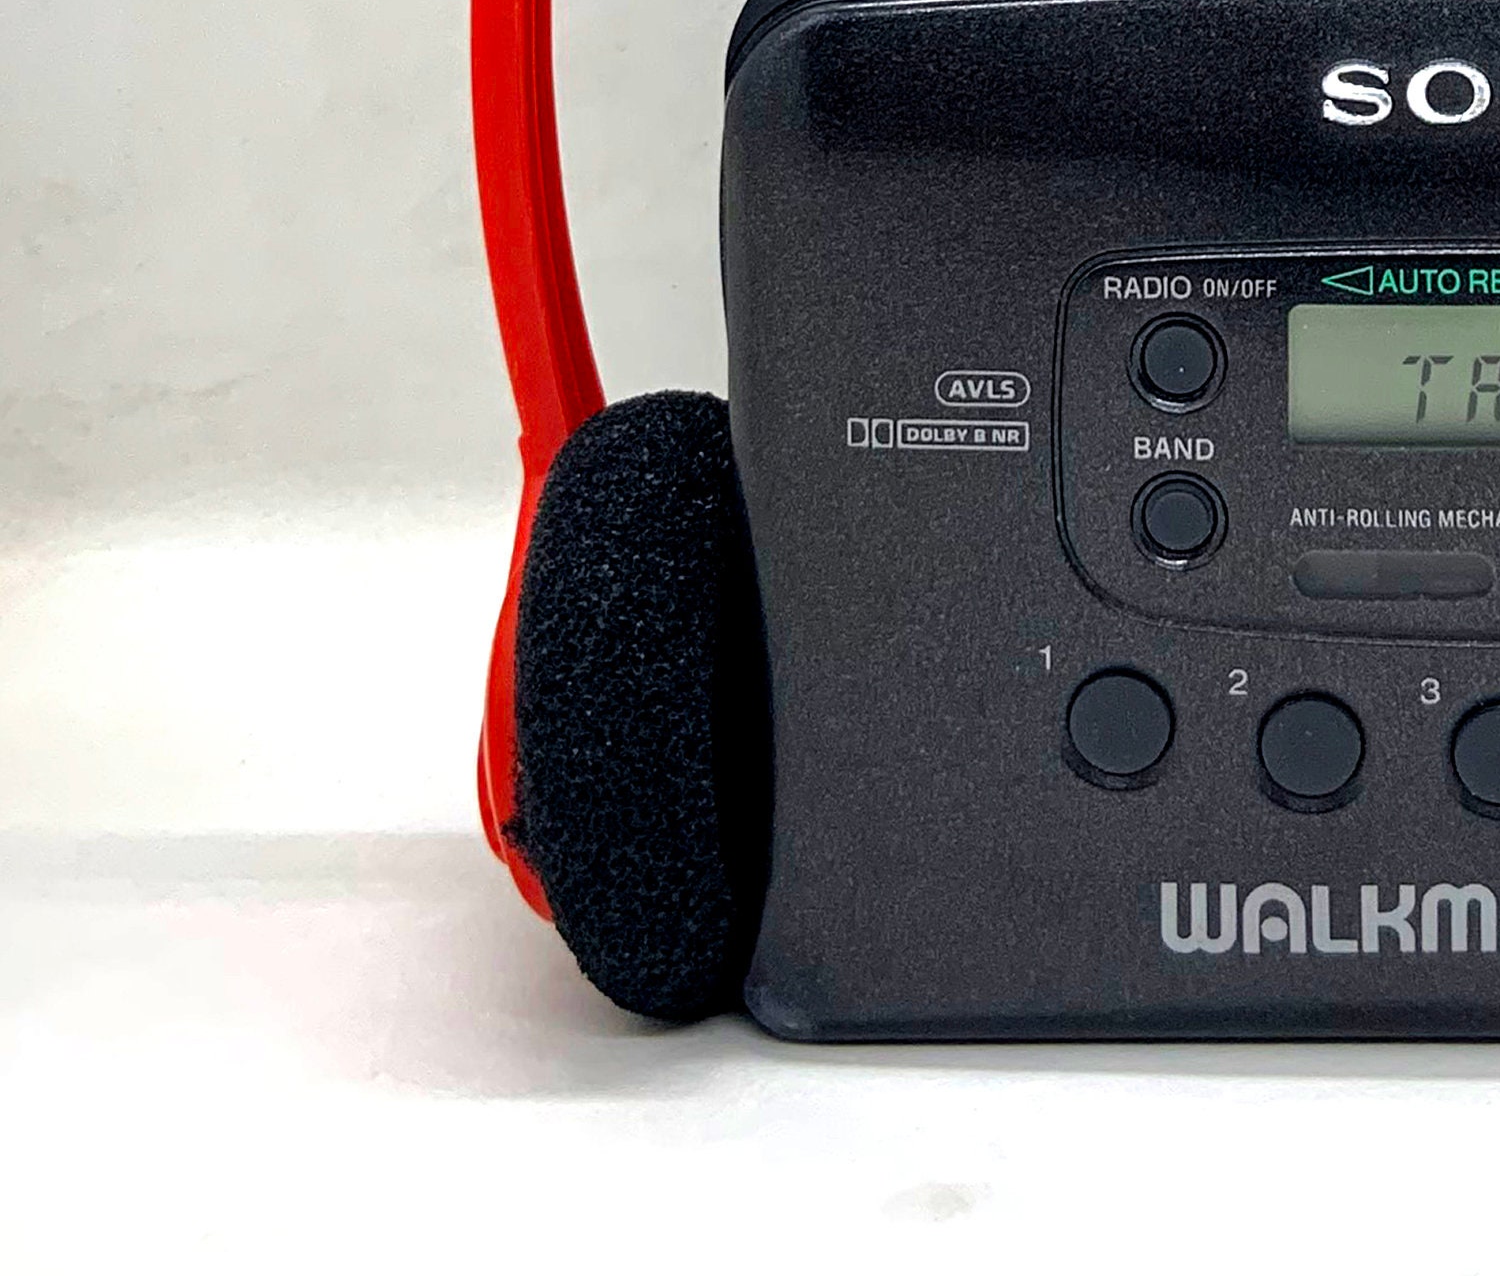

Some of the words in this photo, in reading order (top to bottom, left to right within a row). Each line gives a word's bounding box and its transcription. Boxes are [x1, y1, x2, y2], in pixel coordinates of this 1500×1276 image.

[1104, 276, 1191, 299] RADIO
[1203, 279, 1276, 298] ON/OFF
[1379, 269, 1460, 294] AUTO
[949, 380, 1015, 400] AVLS
[907, 428, 967, 441] DOLBY
[974, 429, 985, 442] B
[992, 429, 1019, 443] NR
[1135, 437, 1214, 460] BAND
[1290, 508, 1431, 528] ANTI-ROLLING
[1040, 646, 1050, 670] 1
[1229, 669, 1247, 695] 2
[1421, 678, 1440, 704] 3
